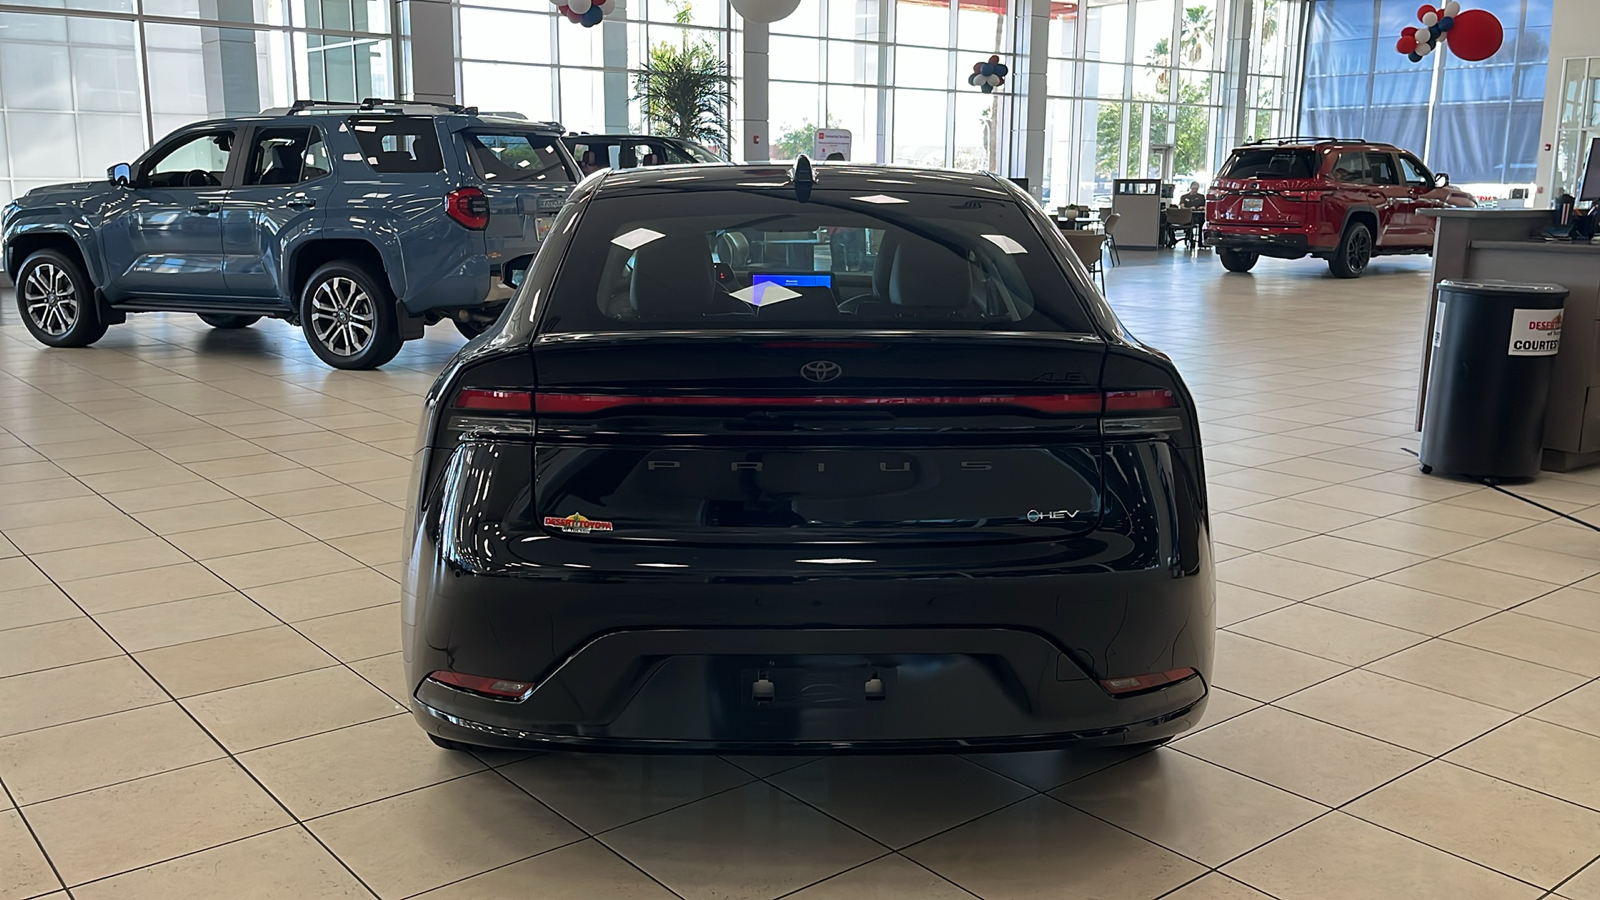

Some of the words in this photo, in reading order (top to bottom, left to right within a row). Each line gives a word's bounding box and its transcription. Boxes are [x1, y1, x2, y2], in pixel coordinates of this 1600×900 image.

[1513, 340, 1558, 350] COURTES
[647, 460, 993, 472] PRIUS
[545, 517, 575, 527] DESERT
[580, 520, 612, 531] TOYOTA
